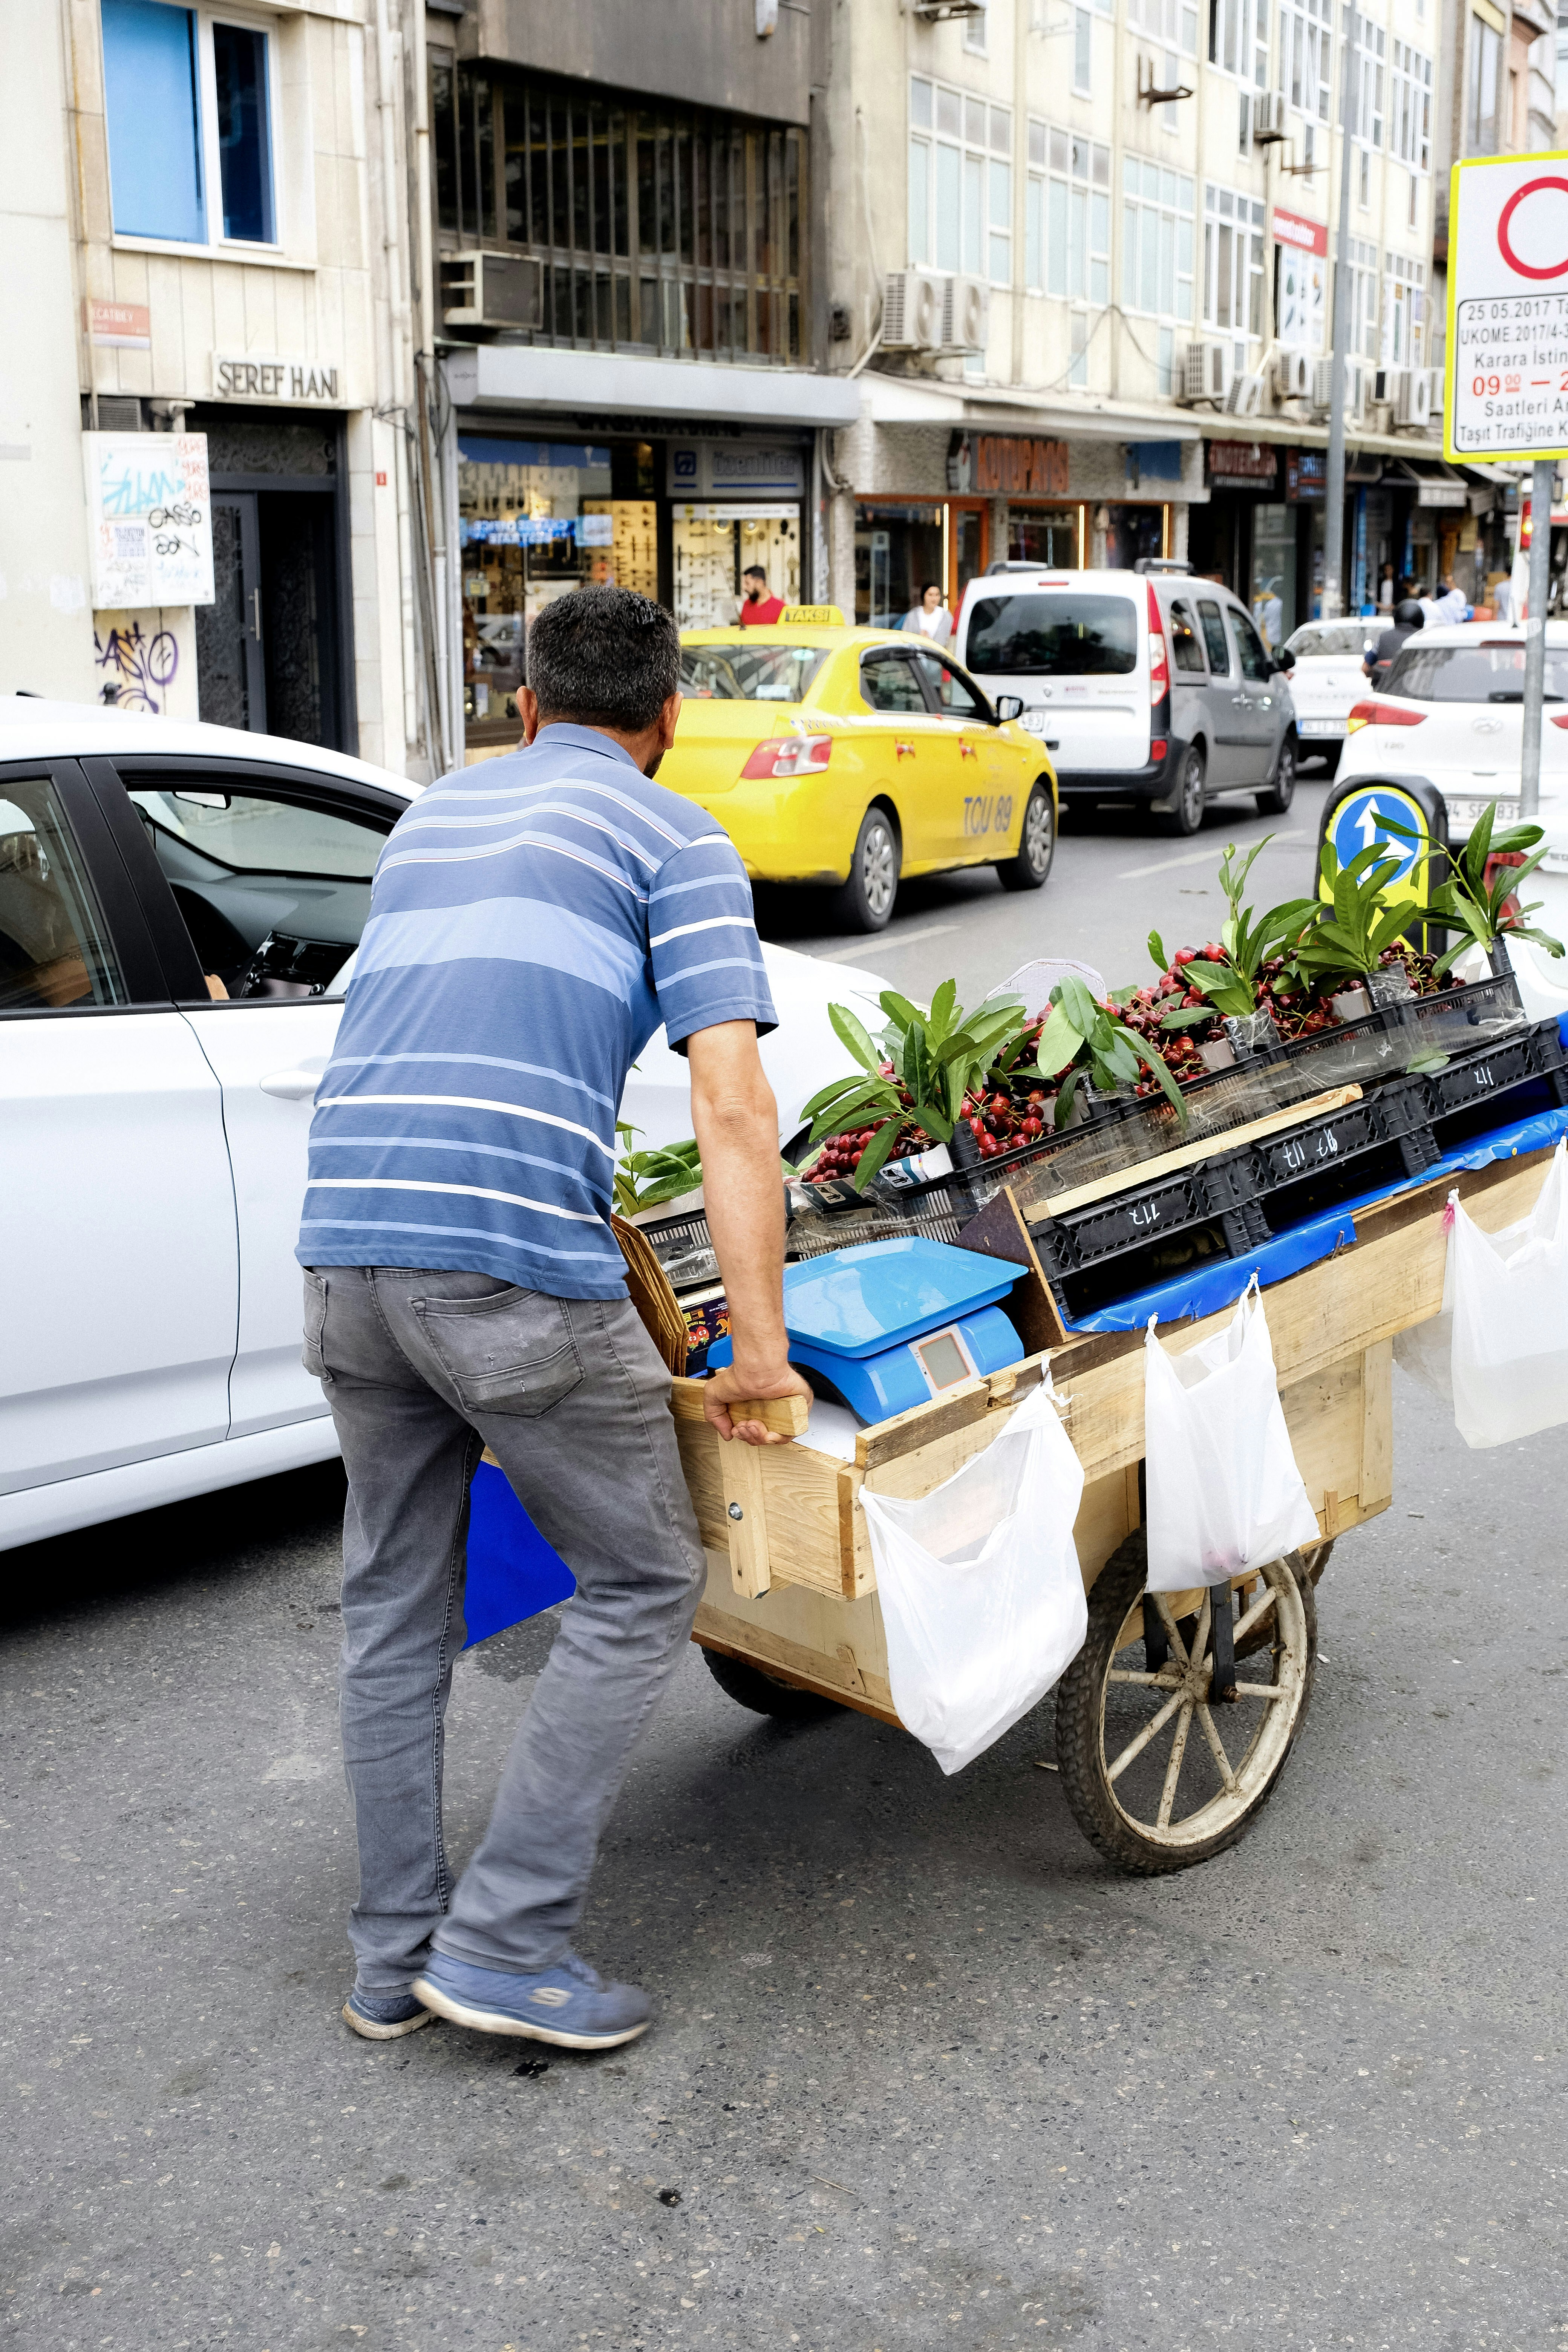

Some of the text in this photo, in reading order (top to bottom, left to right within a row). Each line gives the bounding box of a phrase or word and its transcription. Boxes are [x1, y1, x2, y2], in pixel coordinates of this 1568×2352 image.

[1474, 352, 1527, 368] Karara
[1485, 398, 1547, 416] Saatleri
[1460, 426, 1490, 444] Taşıt
[1496, 422, 1554, 442] Trafiğine
[964, 795, 1013, 836] TCU 89
[1129, 1203, 1160, 1225] 117
